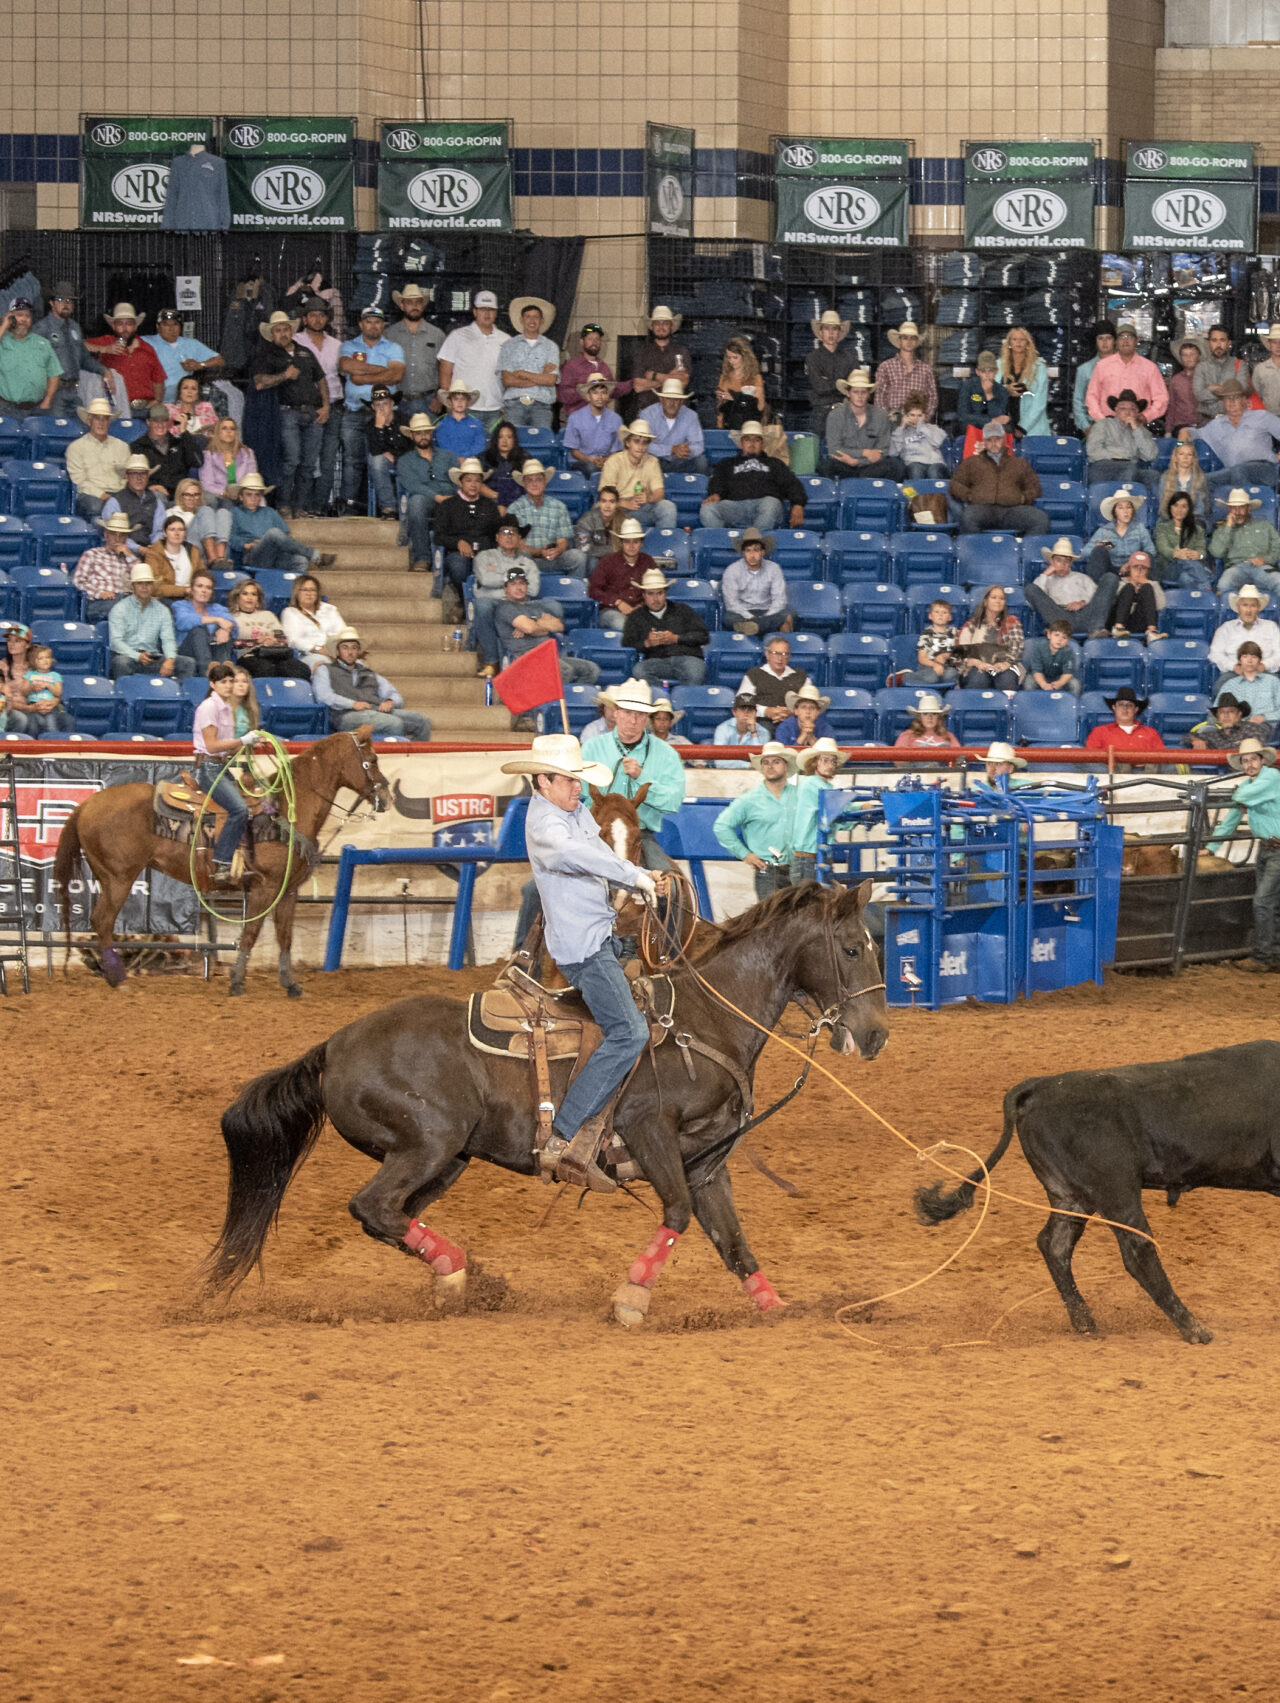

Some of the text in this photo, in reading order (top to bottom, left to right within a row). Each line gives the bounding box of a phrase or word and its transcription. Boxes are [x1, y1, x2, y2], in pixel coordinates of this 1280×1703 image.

[97, 125, 206, 145] NRS 800-GO-ROPIN
[234, 126, 346, 146] NRS 800-GO-ROPIN
[392, 130, 502, 150] NRS 800-GO-ROPIN
[787, 147, 902, 166] NRS 800-GO-ROPIN
[977, 150, 1088, 170] NRS 800-GO-ROPIN
[1138, 150, 1247, 169] NRS 800-GO-ROPIN
[264, 171, 312, 205] NRS
[420, 174, 468, 208] NRS
[817, 191, 866, 225] NRS
[1006, 194, 1053, 227] NRS
[1165, 194, 1212, 228] NRS
[233, 213, 344, 225] NRSworld.com
[388, 216, 501, 228] NRSworld.com
[784, 231, 899, 246] NRSworld.com
[974, 235, 1085, 247] NRSworld.com
[1132, 235, 1244, 248] NRSworld.com
[436, 797, 491, 817] USTRC
[48, 879, 150, 895] POWR
